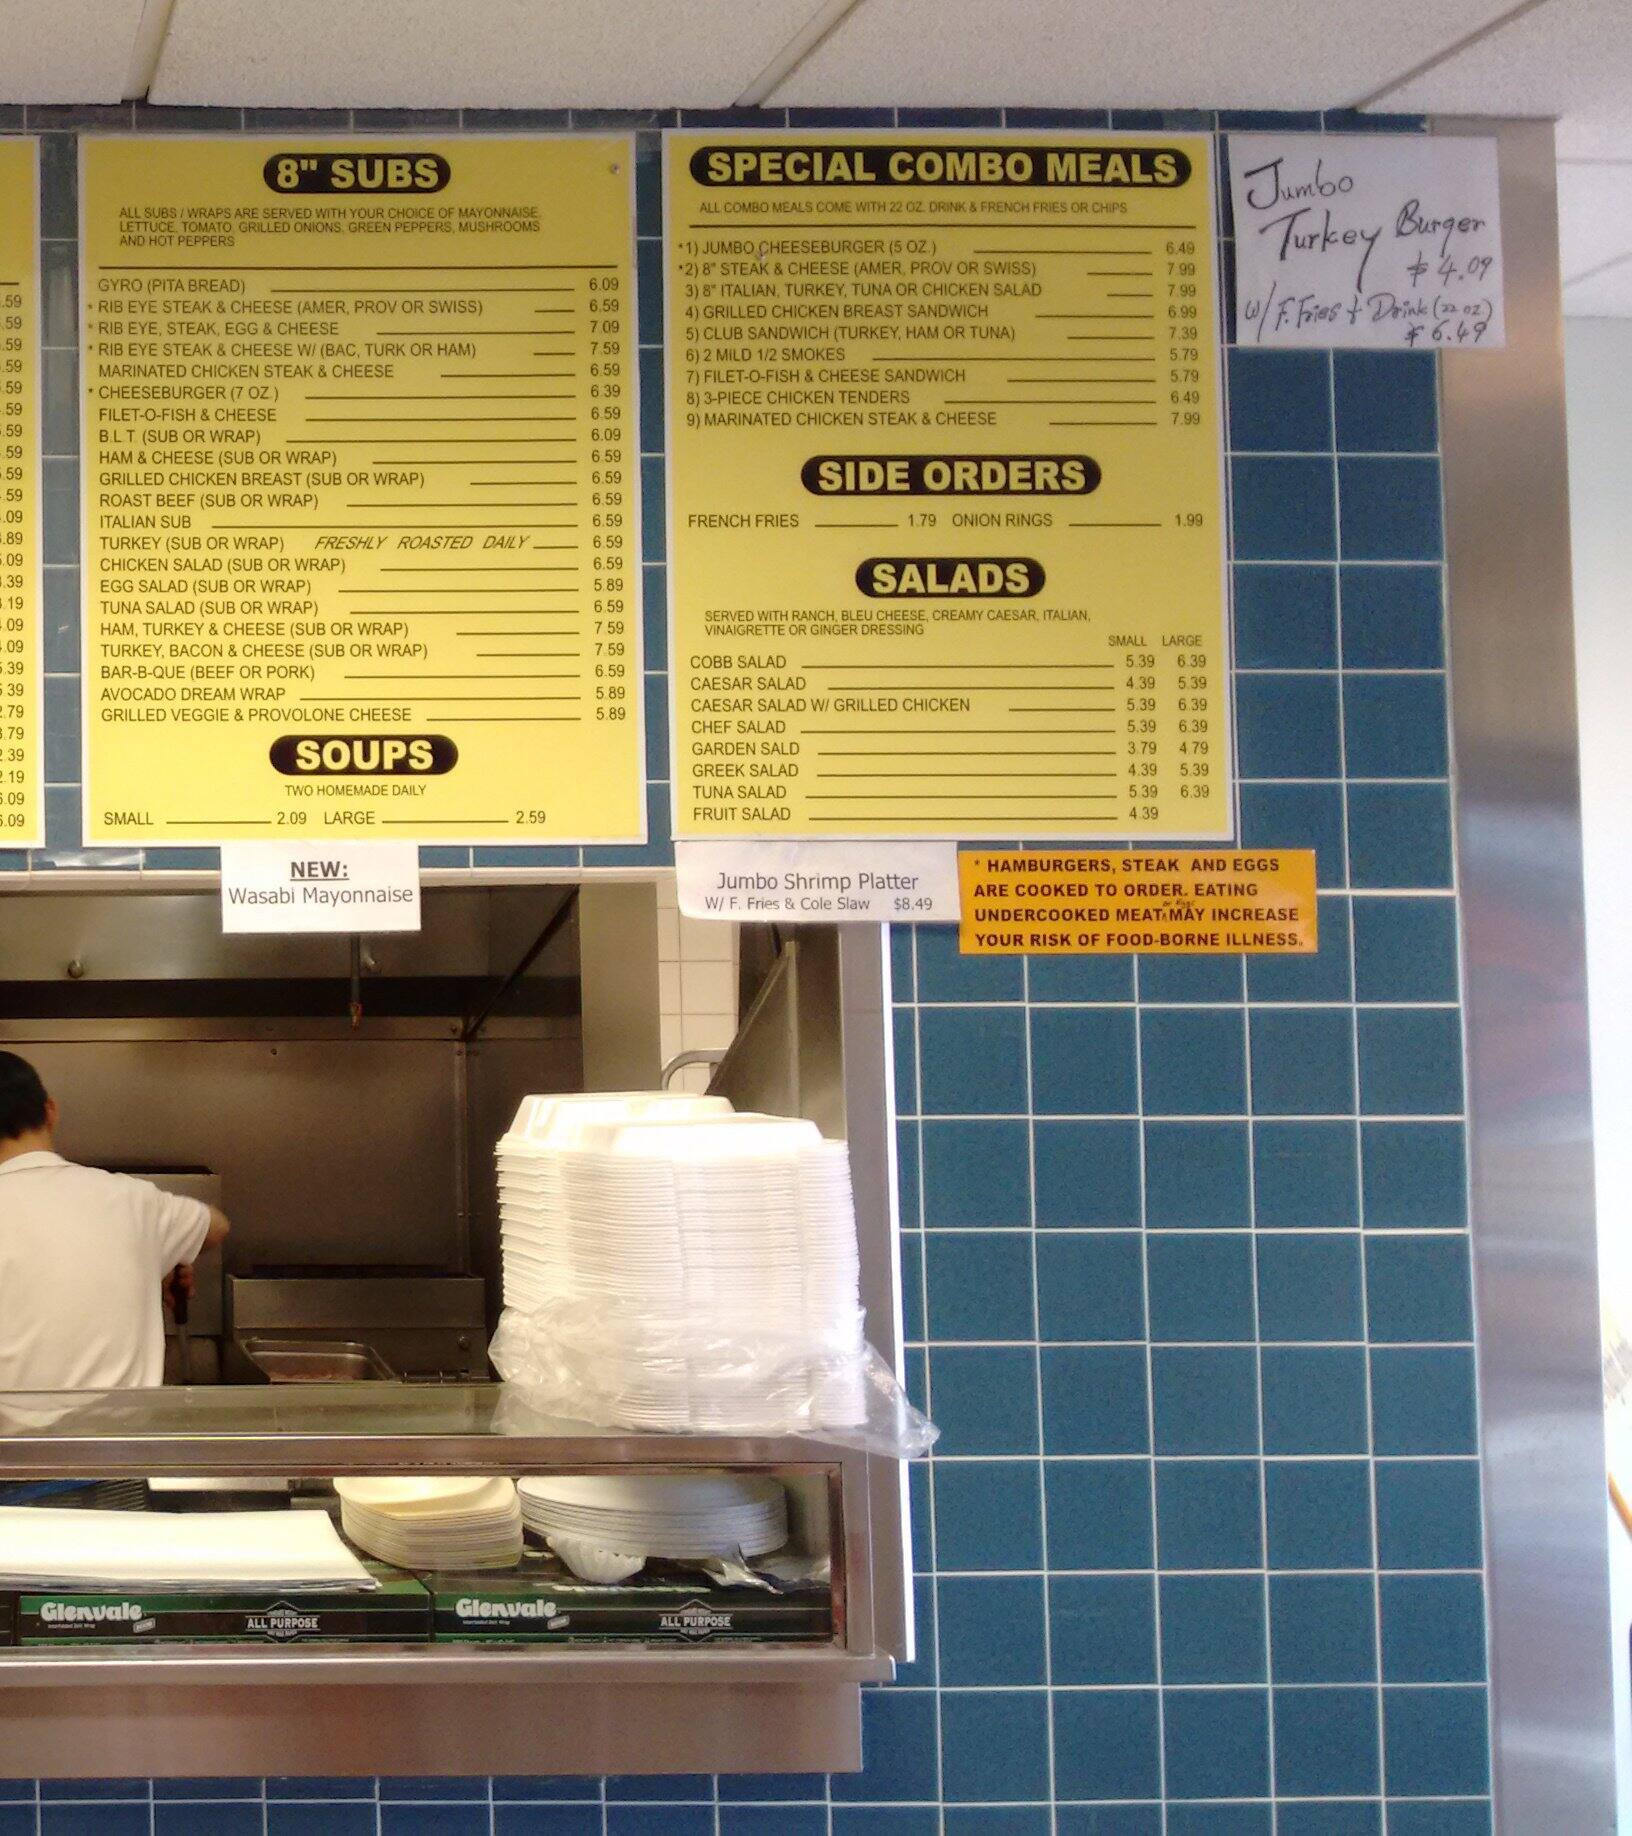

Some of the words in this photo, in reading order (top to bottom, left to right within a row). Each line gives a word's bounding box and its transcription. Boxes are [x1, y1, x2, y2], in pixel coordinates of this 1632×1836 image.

[276, 158, 317, 190] 8"
[331, 158, 439, 190] SUBS
[708, 151, 876, 183] SPECIAL
[889, 151, 1033, 182] COMBO
[1047, 152, 1179, 184] MEALS
[1245, 158, 1353, 209] Jumbo
[1259, 207, 1382, 293] Turkey
[1396, 199, 1485, 258] Burger
[98, 278, 142, 292] GYRO
[147, 278, 184, 295] (PITA
[188, 278, 245, 295] BREAD)
[589, 277, 619, 291] 6.09
[1368, 293, 1427, 321] Drink
[819, 460, 910, 491] SIDE
[924, 460, 1087, 491] ORDERS
[689, 514, 750, 528] FRENCH
[756, 513, 799, 528] FRIES
[909, 513, 936, 527] 1.79
[953, 513, 1000, 527] ONION
[1006, 513, 1052, 528] RINGS
[1176, 512, 1203, 527] 1.99
[873, 563, 1031, 594] SALADS
[691, 655, 732, 669] COBB
[738, 654, 786, 669] SALAD
[1177, 654, 1206, 668] 6.39
[101, 687, 176, 701] AVOCADO
[181, 687, 235, 701] DREAM
[240, 687, 285, 701] WRAP
[296, 741, 434, 771] SOUPS
[285, 784, 313, 796] TWO
[317, 784, 388, 796] HOMEMADE
[393, 784, 426, 796] DAILY
[104, 811, 153, 825] SMALL
[277, 811, 306, 824] 2.09
[325, 811, 375, 825] LARGE
[516, 811, 546, 825] 2.59
[290, 860, 349, 882] NEW:
[988, 858, 1115, 874] HAMBURGERS,
[1123, 859, 1179, 872] STEAK
[1191, 858, 1226, 872] AND
[1233, 858, 1279, 872] EGGS
[717, 872, 778, 889] Jumbo
[785, 872, 851, 894] Shrimp
[859, 872, 918, 890] Platter
[974, 884, 1008, 897] ARE
[1015, 883, 1088, 897] COOKED
[1095, 884, 1117, 897] TO
[1124, 883, 1187, 897] ORDER.
[1195, 883, 1257, 897] EATING
[229, 887, 294, 905] Wasabi
[303, 886, 413, 908] Mayonnaise
[705, 896, 724, 912] W/
[730, 896, 740, 910] F.
[747, 896, 779, 910] Fries
[785, 897, 795, 910] &
[800, 896, 831, 911] Cole
[837, 896, 870, 911] Slaw
[894, 896, 932, 911] $8.49
[975, 908, 1109, 921] UNDERCOOKED
[1117, 908, 1163, 921] MEAT
[1169, 907, 1204, 921] MAY
[1212, 908, 1298, 921] INCREASE
[975, 933, 1023, 946] YOUR
[1030, 933, 1070, 946] RISK
[1078, 933, 1100, 946] OF
[1107, 932, 1219, 946] FOOD-BORNE
[41, 1602, 142, 1622] Glenvale
[455, 1598, 557, 1619] Glenvale
[247, 1617, 268, 1629] ALL
[271, 1617, 318, 1629] PURPOSE
[660, 1615, 681, 1627] ALL
[684, 1615, 731, 1627] PURPOSE
